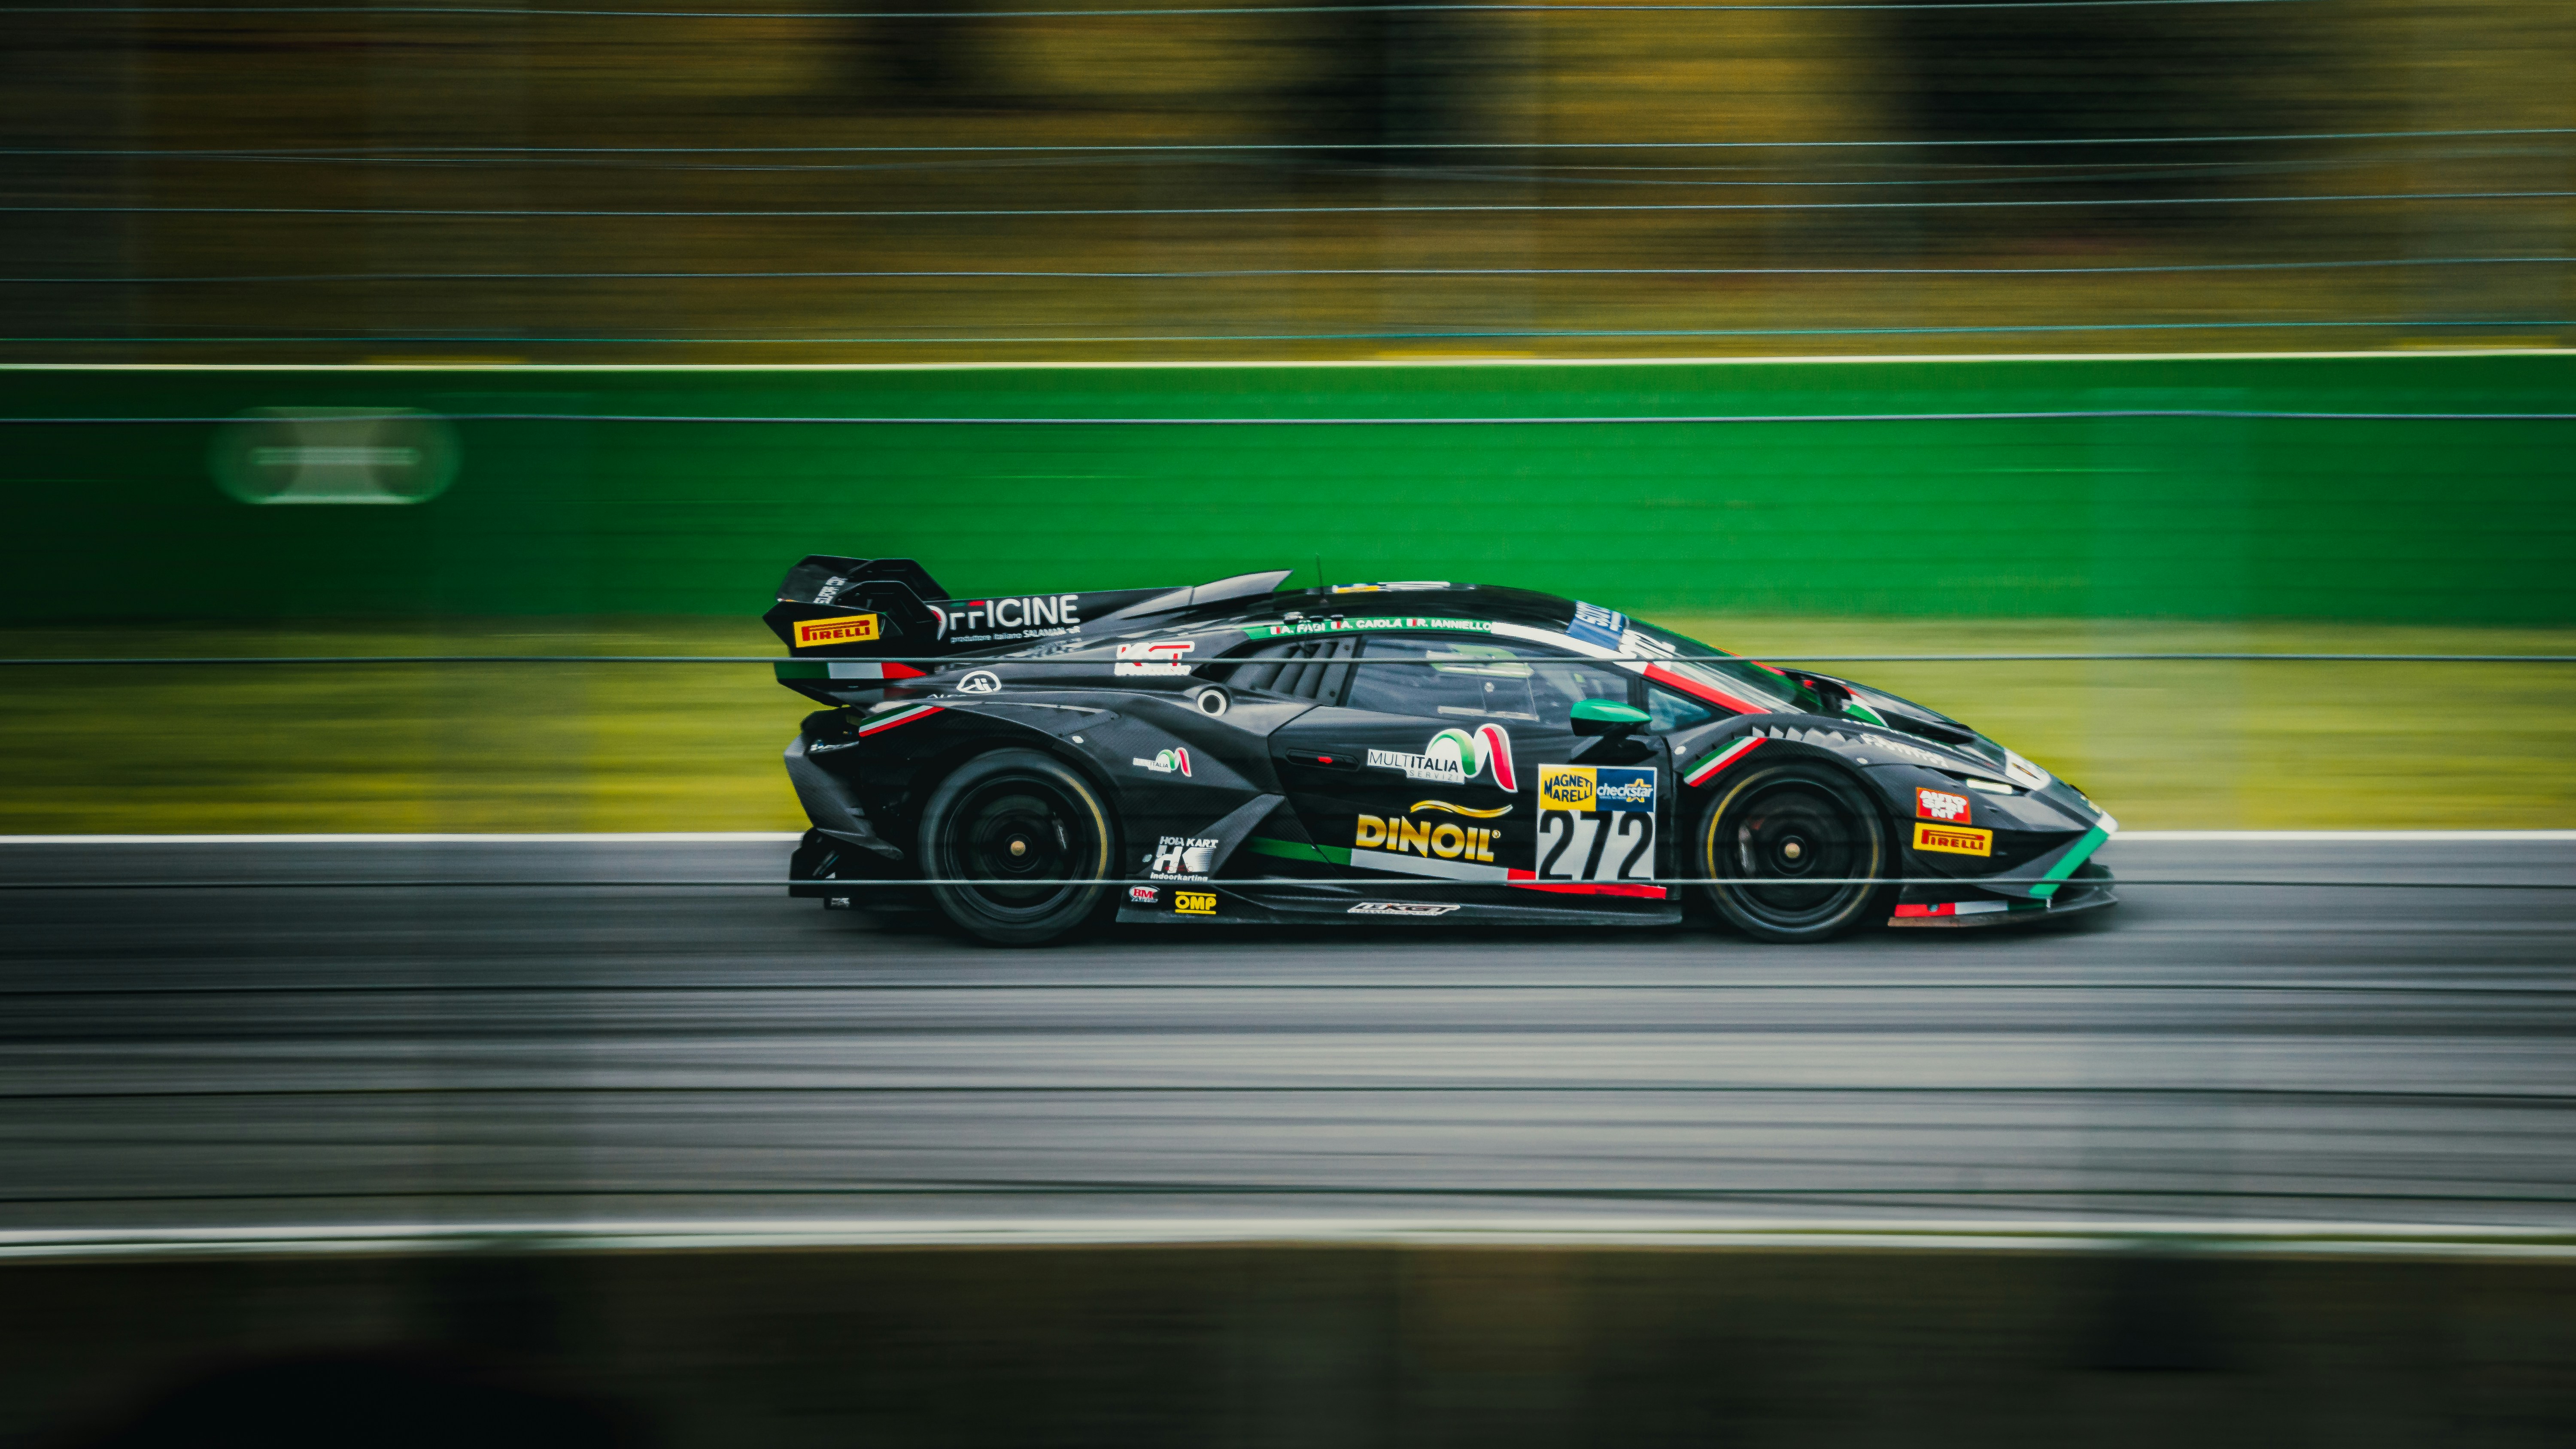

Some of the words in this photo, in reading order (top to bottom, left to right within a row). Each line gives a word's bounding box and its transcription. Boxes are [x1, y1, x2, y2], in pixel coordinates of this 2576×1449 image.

[802, 620, 870, 641] PIRELLI
[1356, 620, 1402, 628] CAIOLA
[1431, 620, 1492, 630] IANNIELLO
[1370, 752, 1458, 773] MULTITALIA
[1410, 770, 1459, 781] SERVIZI
[1544, 774, 1592, 796] MAGNETI
[1597, 783, 1653, 798] checkstar
[1920, 790, 1967, 805] AUTO
[1186, 838, 1218, 848] KART
[1539, 810, 1653, 880] 272
[1921, 829, 1985, 850] PIRELLI
[1151, 872, 1208, 881] indoorkarting
[1176, 896, 1216, 910] OMP
